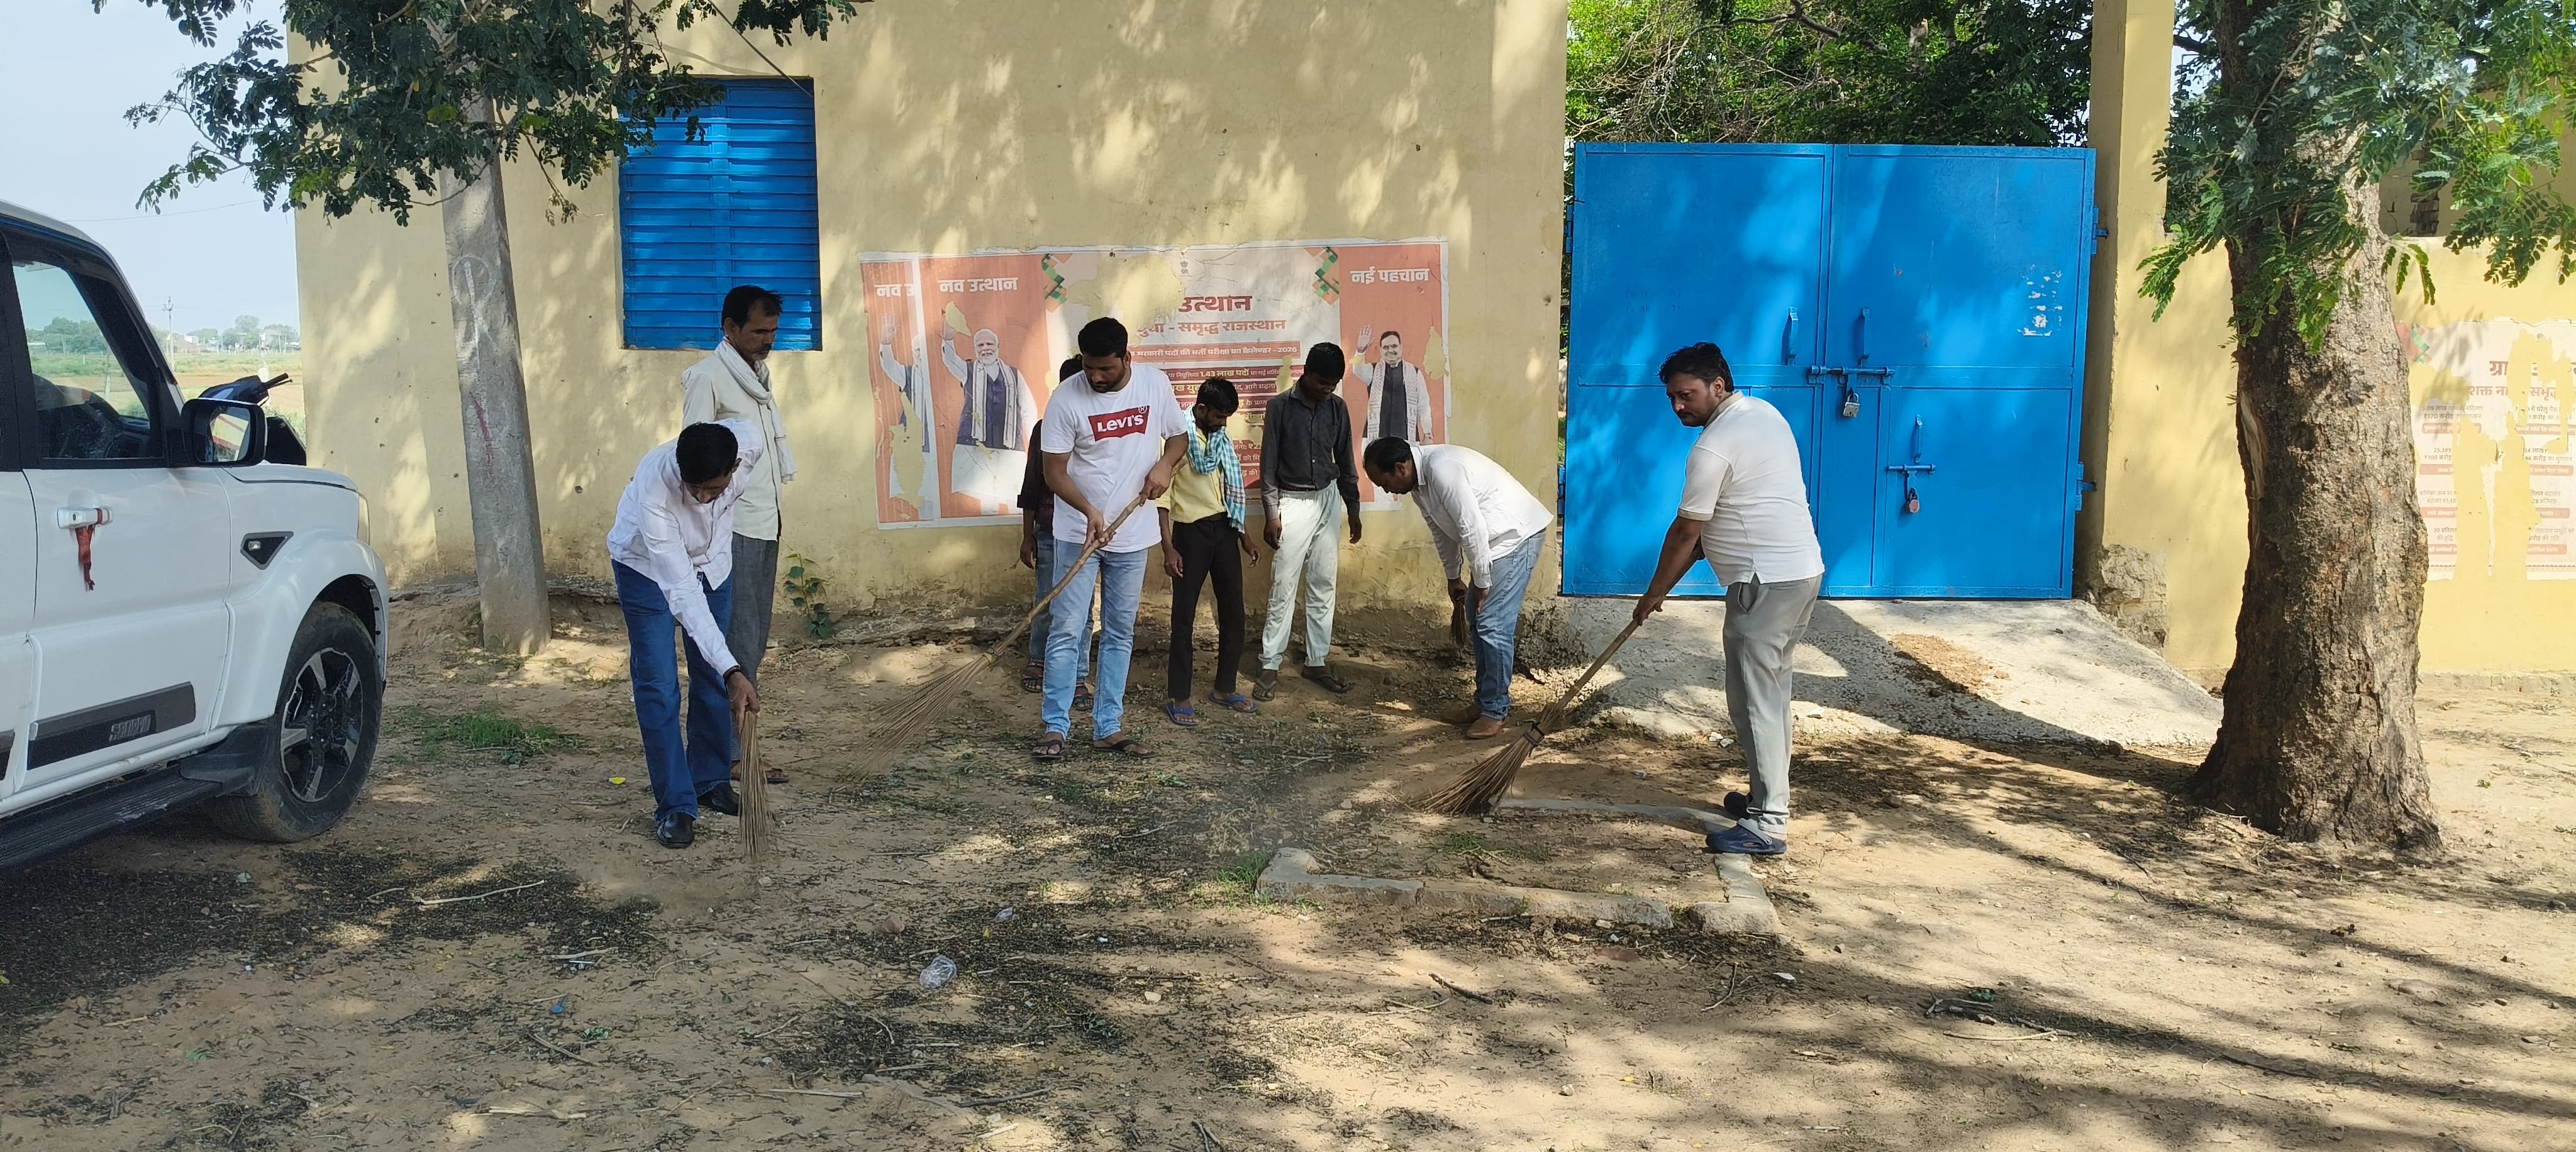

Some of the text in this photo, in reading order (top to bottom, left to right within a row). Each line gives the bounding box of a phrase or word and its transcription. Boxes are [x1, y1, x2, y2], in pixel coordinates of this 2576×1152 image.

[1350, 266, 1430, 284] नई पहचान
[874, 284, 902, 297] नव
[937, 277, 1018, 292] नव उत्थान
[1179, 296, 1252, 313] उत्थान
[1178, 322, 1219, 336] समृद्ध
[1223, 320, 1286, 332] राजस्थान
[1180, 348, 1190, 356] की
[2469, 385, 2493, 396] शक्त
